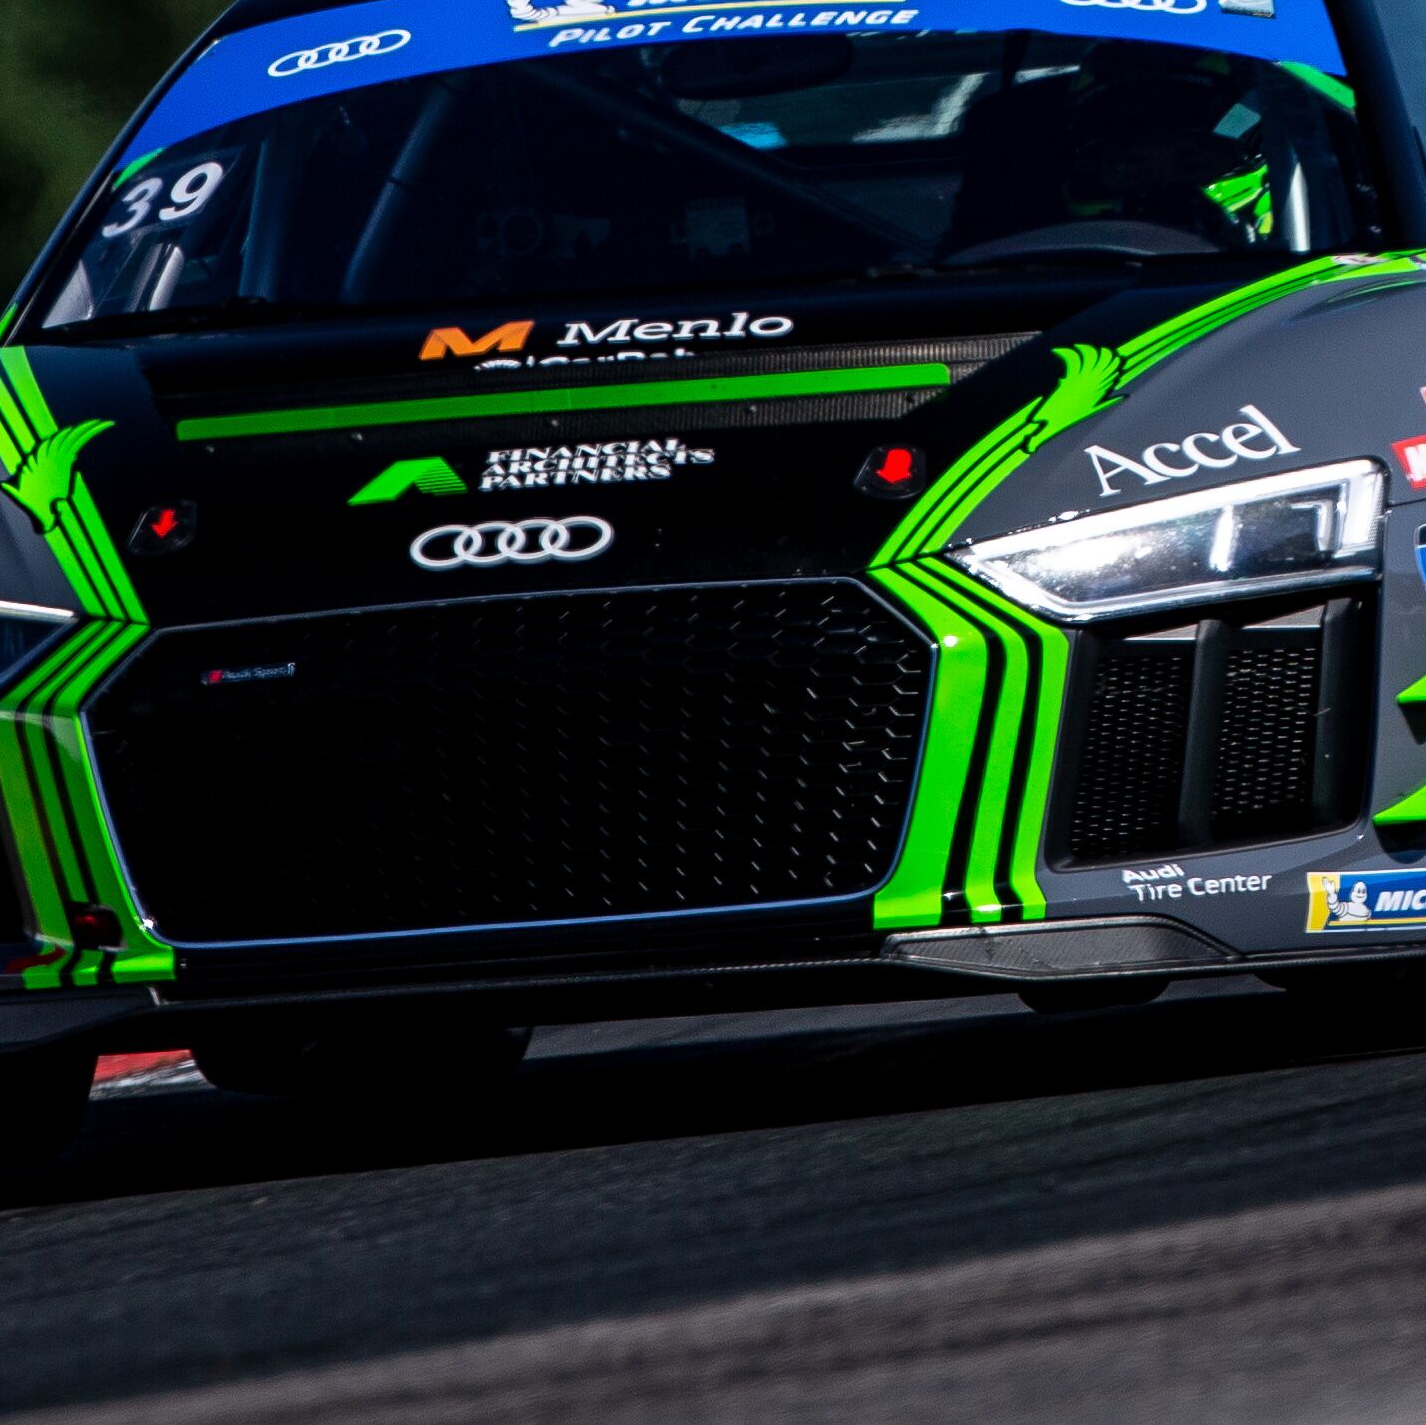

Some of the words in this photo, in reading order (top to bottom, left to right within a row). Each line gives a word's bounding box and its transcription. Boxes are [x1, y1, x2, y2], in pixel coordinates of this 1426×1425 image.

[549, 20, 672, 48] PILOT
[681, 8, 921, 35] CHALLENGE
[102, 162, 223, 238] 39
[556, 311, 795, 347] Menlo
[486, 438, 687, 464] FINANCIAL
[1085, 405, 1302, 498] Accel
[478, 464, 671, 492] PARTNERS
[1122, 864, 1185, 883] Audi
[1126, 881, 1183, 904] Tire
[1186, 874, 1273, 896] Center
